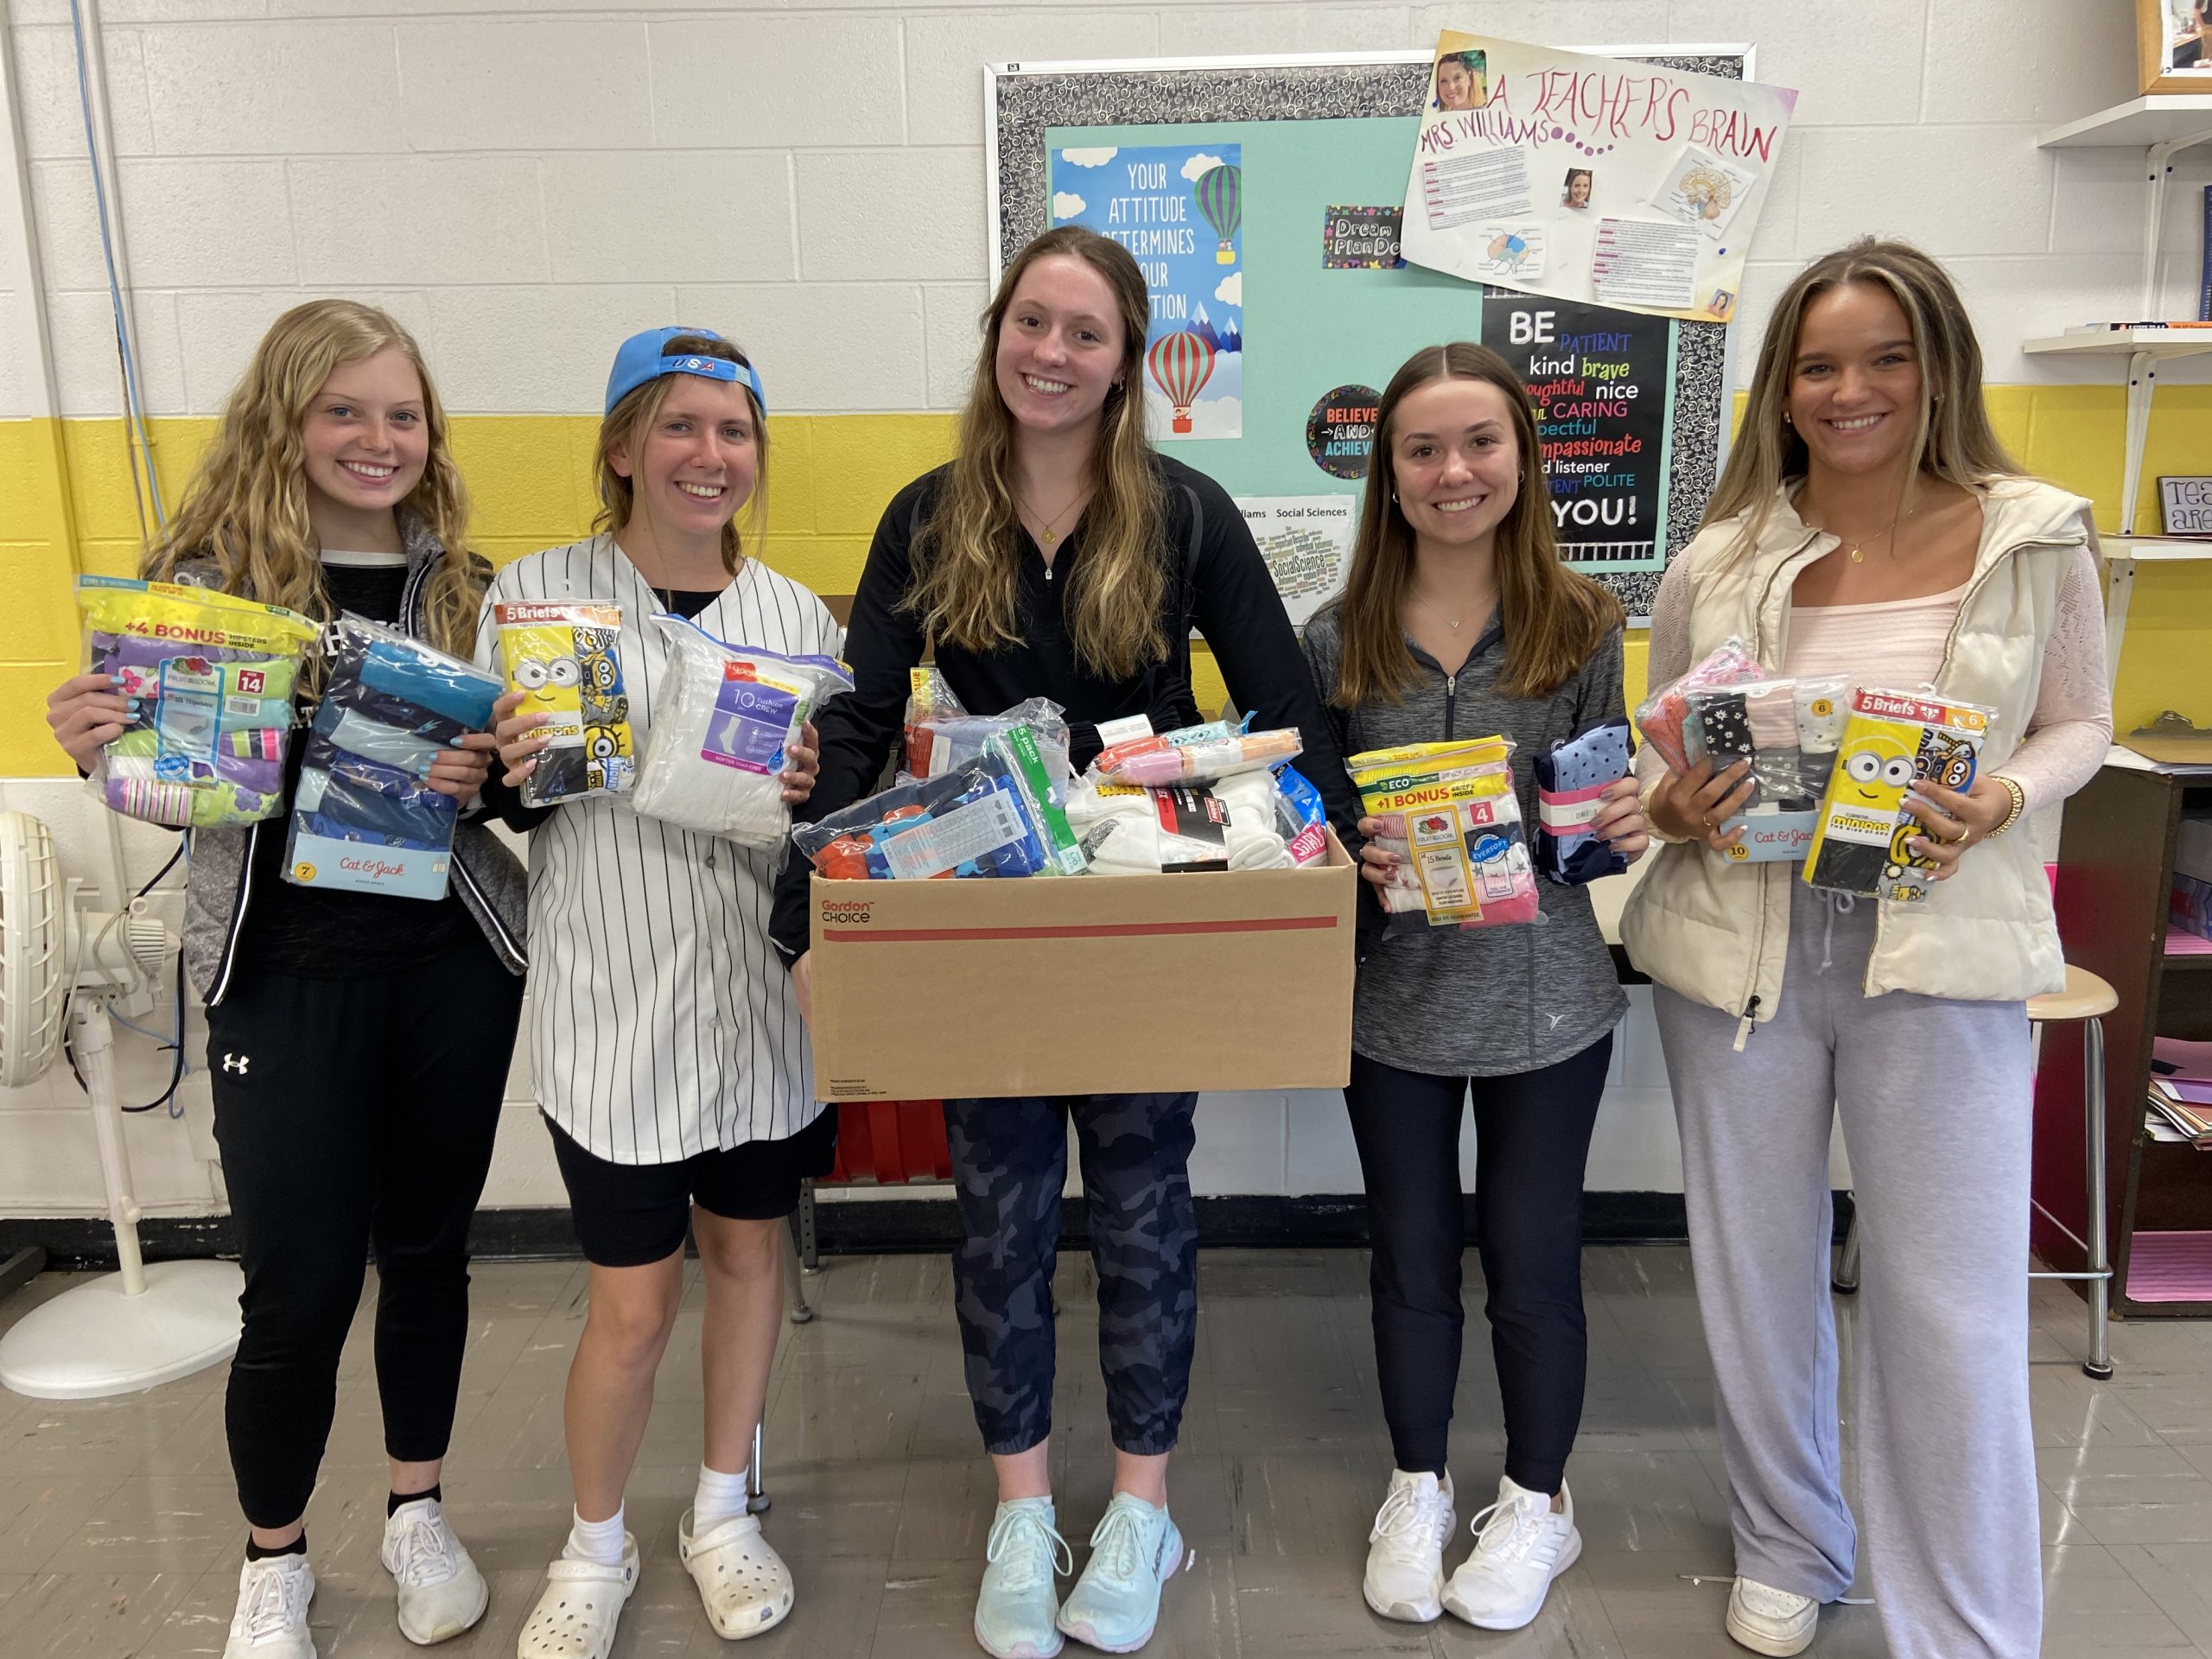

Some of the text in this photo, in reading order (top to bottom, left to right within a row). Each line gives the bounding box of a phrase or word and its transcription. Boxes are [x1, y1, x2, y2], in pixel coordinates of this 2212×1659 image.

[1486, 65, 1777, 163] A TEACHER'S BRAIN
[1457, 111, 1548, 149] WILLIAMS
[1128, 162, 1166, 190] YOUR
[1109, 196, 1186, 224] ATTITUDE
[1335, 219, 1392, 238] Dream
[1141, 262, 1168, 288] OUR
[1510, 310, 1631, 354] BE PATIENT
[672, 358, 715, 372] USA
[1529, 354, 1630, 379] kind brave
[1524, 378, 1639, 406] oughtful nice
[1326, 407, 1378, 423] BELIEVE
[1553, 401, 1628, 420] CARING
[1333, 424, 1370, 440] AND
[1537, 419, 1597, 435] pectful
[1325, 441, 1373, 456] ACHIEV
[1541, 433, 1642, 462] mpassionate
[1555, 460, 1611, 474] listener
[1583, 474, 1636, 487] POLITE
[1276, 507, 1304, 518] Social
[1306, 507, 1347, 517] Sciences
[1551, 495, 1637, 527] YOU!
[1272, 553, 1325, 577] SocialScience
[506, 607, 559, 621] 5 Briefs
[125, 622, 226, 645] +4 BONUS
[229, 633, 267, 645] HIPSTERS
[228, 639, 255, 649] INSIDE
[241, 677, 261, 692] 14
[734, 689, 784, 709] 10 cushion
[1861, 696, 1916, 716] 5 Briefs
[755, 703, 778, 715] CREW
[1818, 704, 1826, 713] 6
[1968, 715, 1978, 726] 6
[1020, 737, 1039, 764] pack
[715, 755, 734, 766] SOFTER
[1389, 778, 1410, 790] ECO
[1451, 783, 1475, 793] BRIEFS
[1377, 787, 1450, 809] +1 BONUS
[1452, 789, 1475, 798] INSIDE
[1477, 807, 1489, 822] 4
[1832, 815, 1891, 832] minions
[1755, 829, 1813, 848] Cat & Jac
[1472, 839, 1508, 860] EVERSOFT
[1731, 847, 1745, 855] 10
[302, 866, 310, 875] 7
[340, 857, 404, 879] Cat & Jack
[822, 899, 870, 912] Gordon
